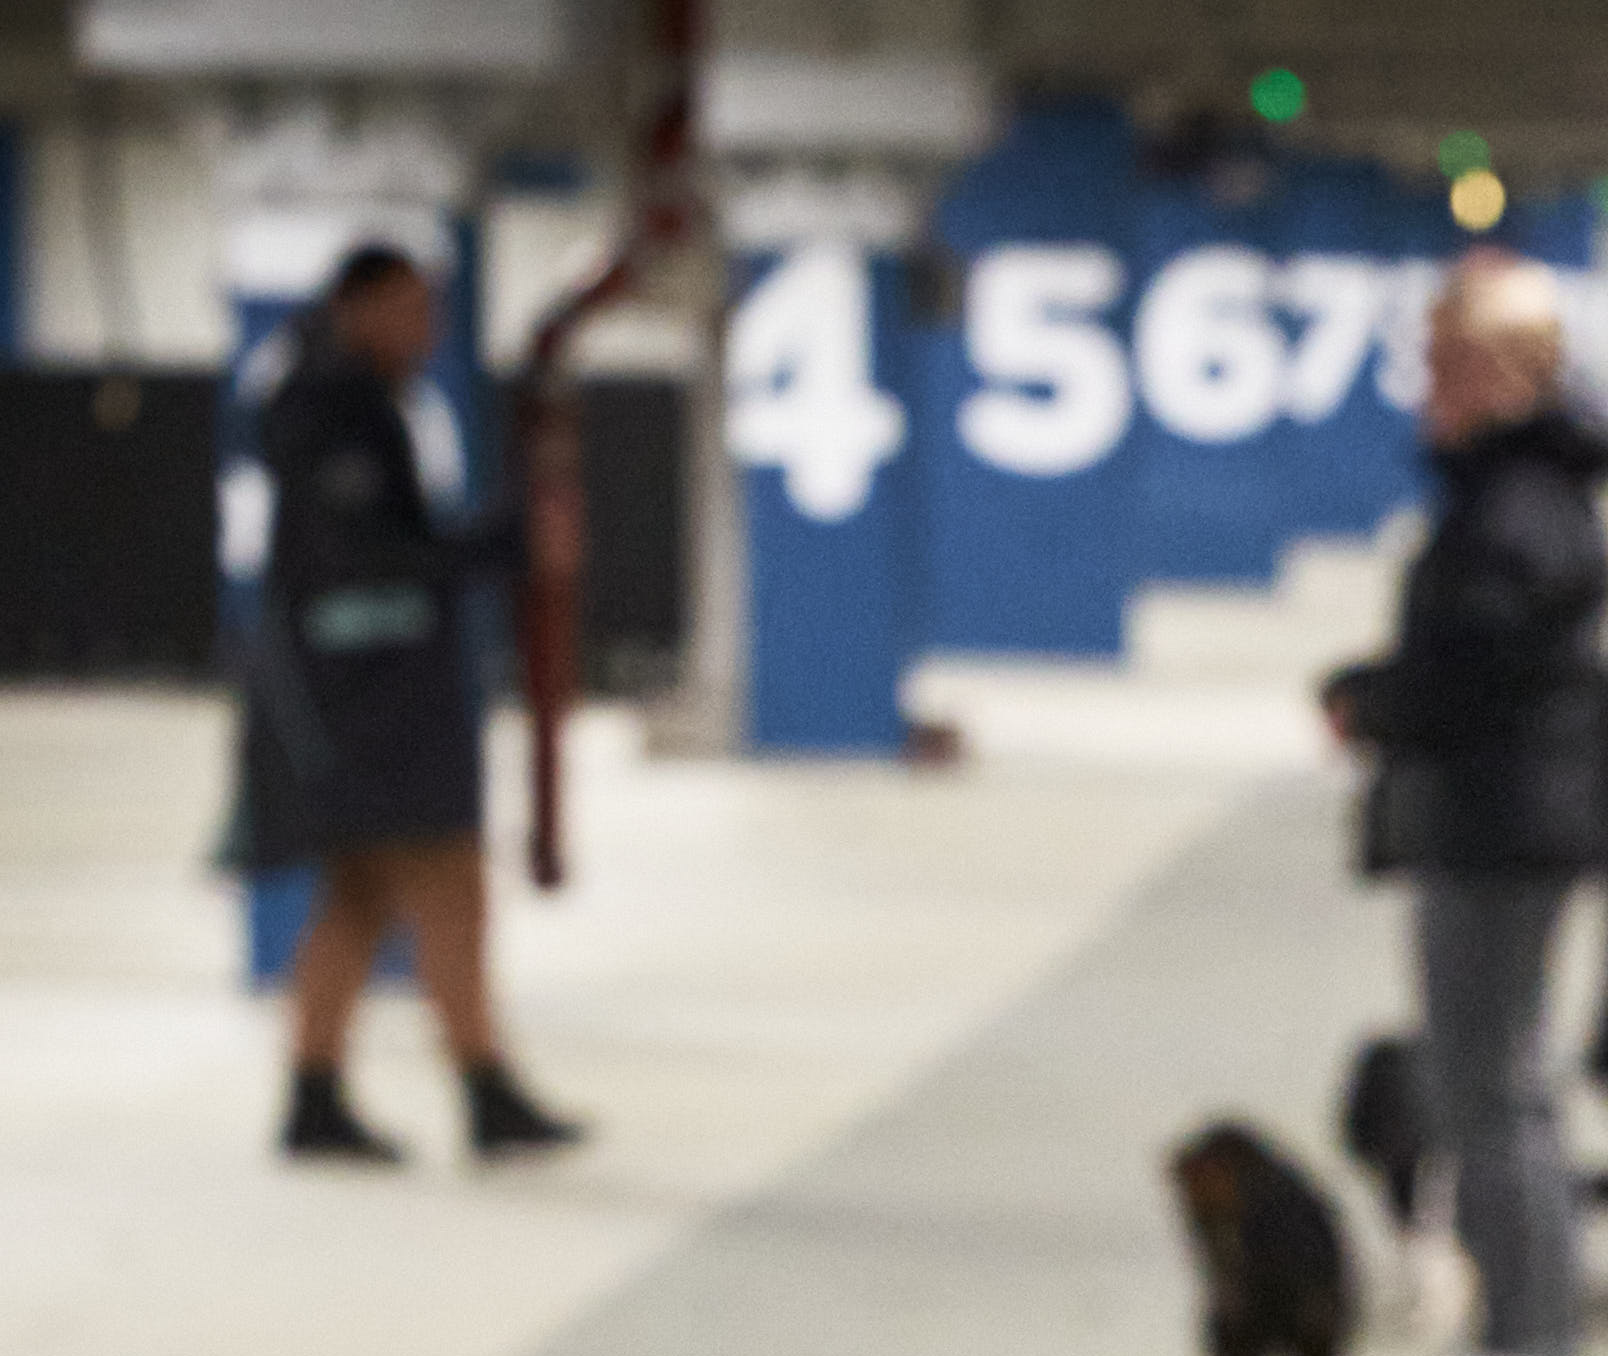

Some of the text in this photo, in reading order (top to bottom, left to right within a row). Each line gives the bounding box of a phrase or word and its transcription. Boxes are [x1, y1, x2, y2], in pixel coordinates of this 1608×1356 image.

[725, 248, 906, 523] 4
[956, 241, 1135, 478] 5
[1134, 244, 1288, 444] 6
